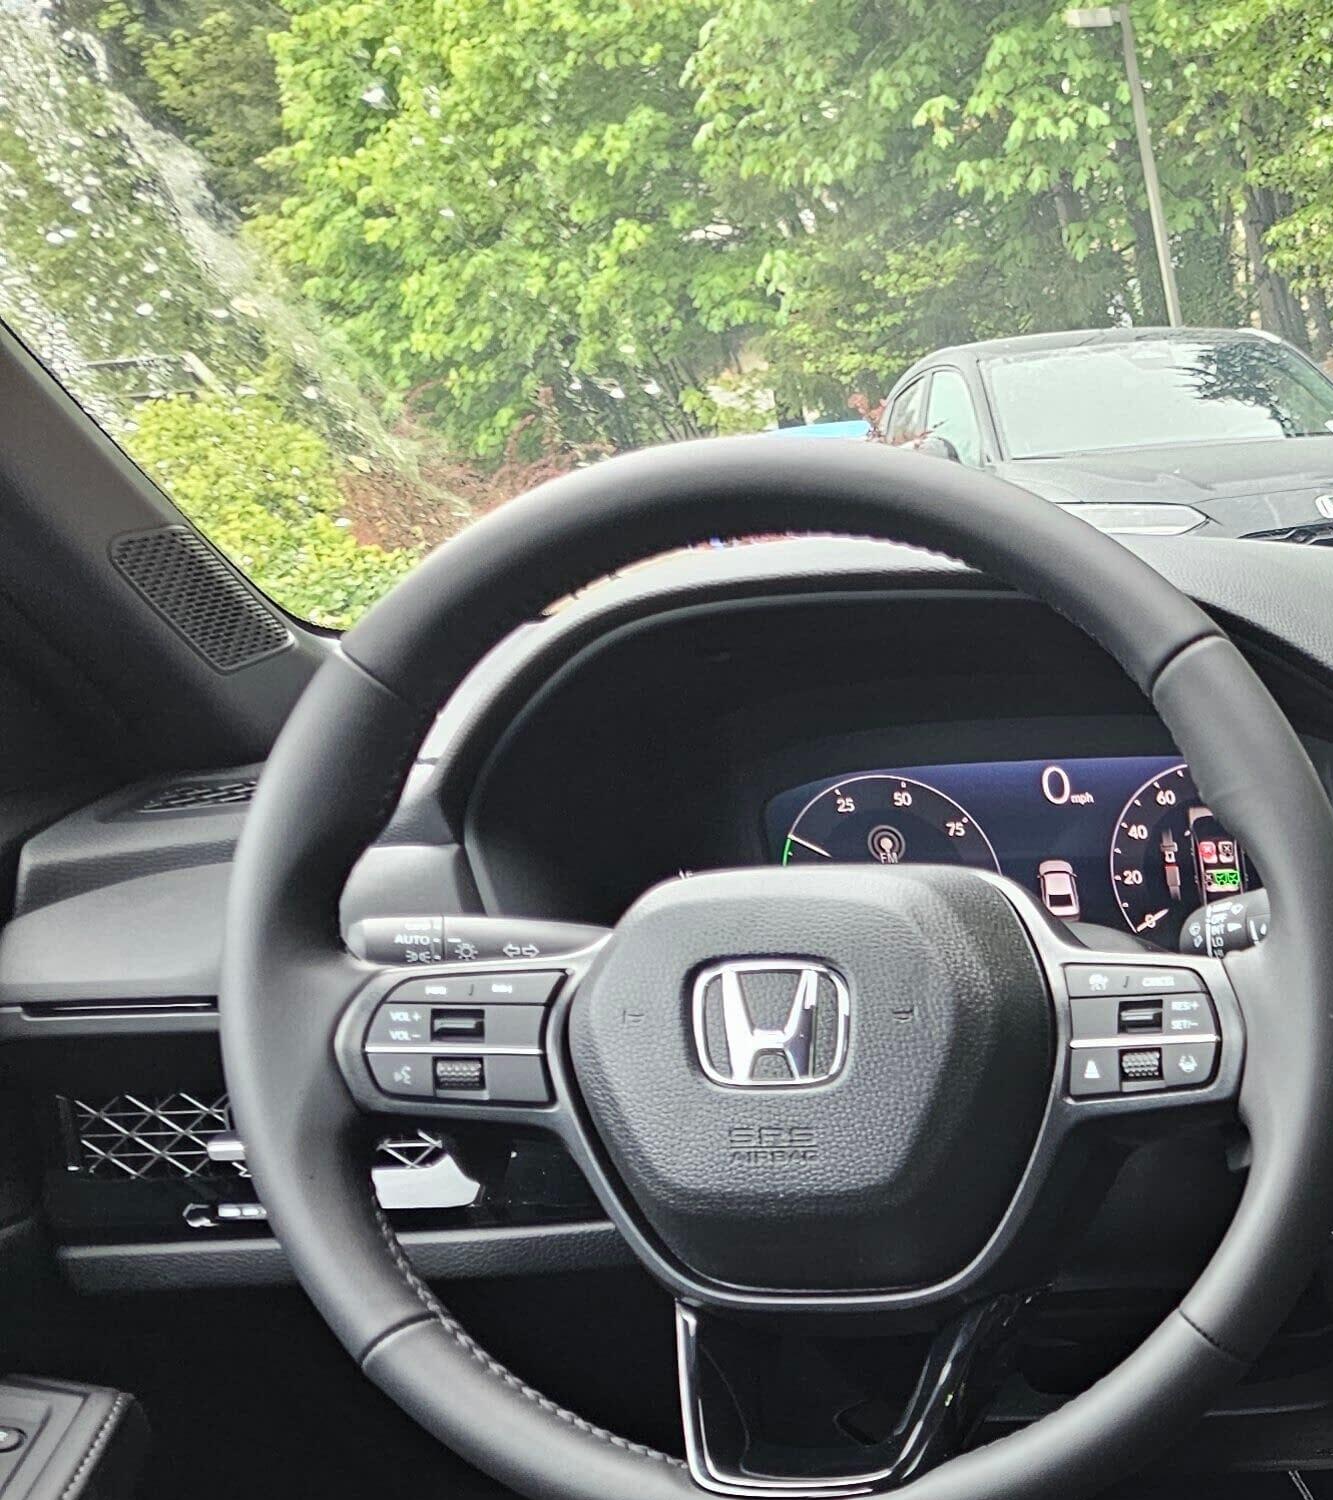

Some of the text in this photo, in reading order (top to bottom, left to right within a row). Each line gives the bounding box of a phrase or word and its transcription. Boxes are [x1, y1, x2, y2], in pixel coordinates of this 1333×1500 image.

[1042, 765, 1095, 806] 0 mph
[836, 797, 856, 813] 25
[892, 791, 913, 807] 50
[1156, 789, 1177, 806] 60
[945, 821, 967, 837] 75
[1127, 824, 1149, 841] 40
[880, 852, 899, 863] FM
[1123, 869, 1143, 885] 20
[394, 934, 430, 946] AUTO
